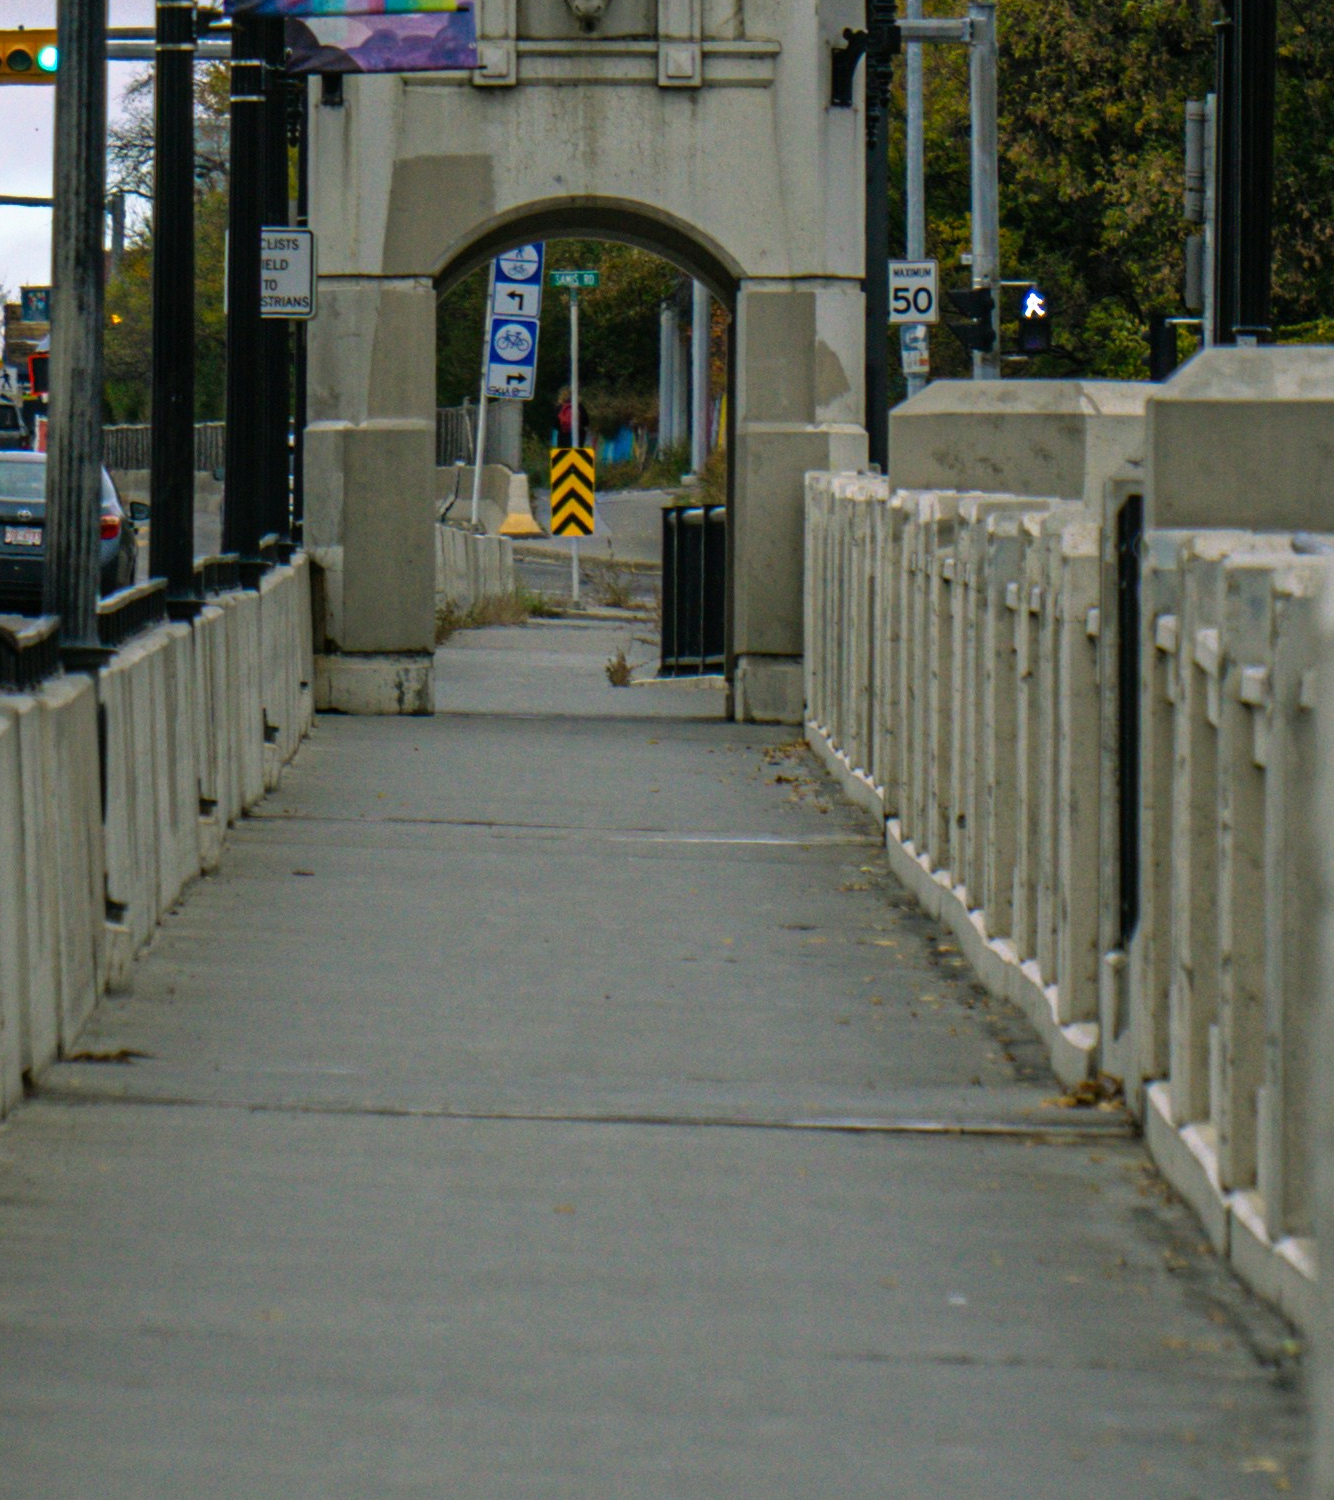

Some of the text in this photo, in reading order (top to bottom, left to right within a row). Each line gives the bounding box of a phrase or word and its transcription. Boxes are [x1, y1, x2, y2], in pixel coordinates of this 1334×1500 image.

[261, 238, 299, 250] CLISTS
[262, 259, 289, 271] IELD
[893, 267, 931, 278] MAXIMUM
[263, 279, 278, 291] TO
[260, 296, 309, 308] STRIANS
[892, 286, 933, 315] 50
